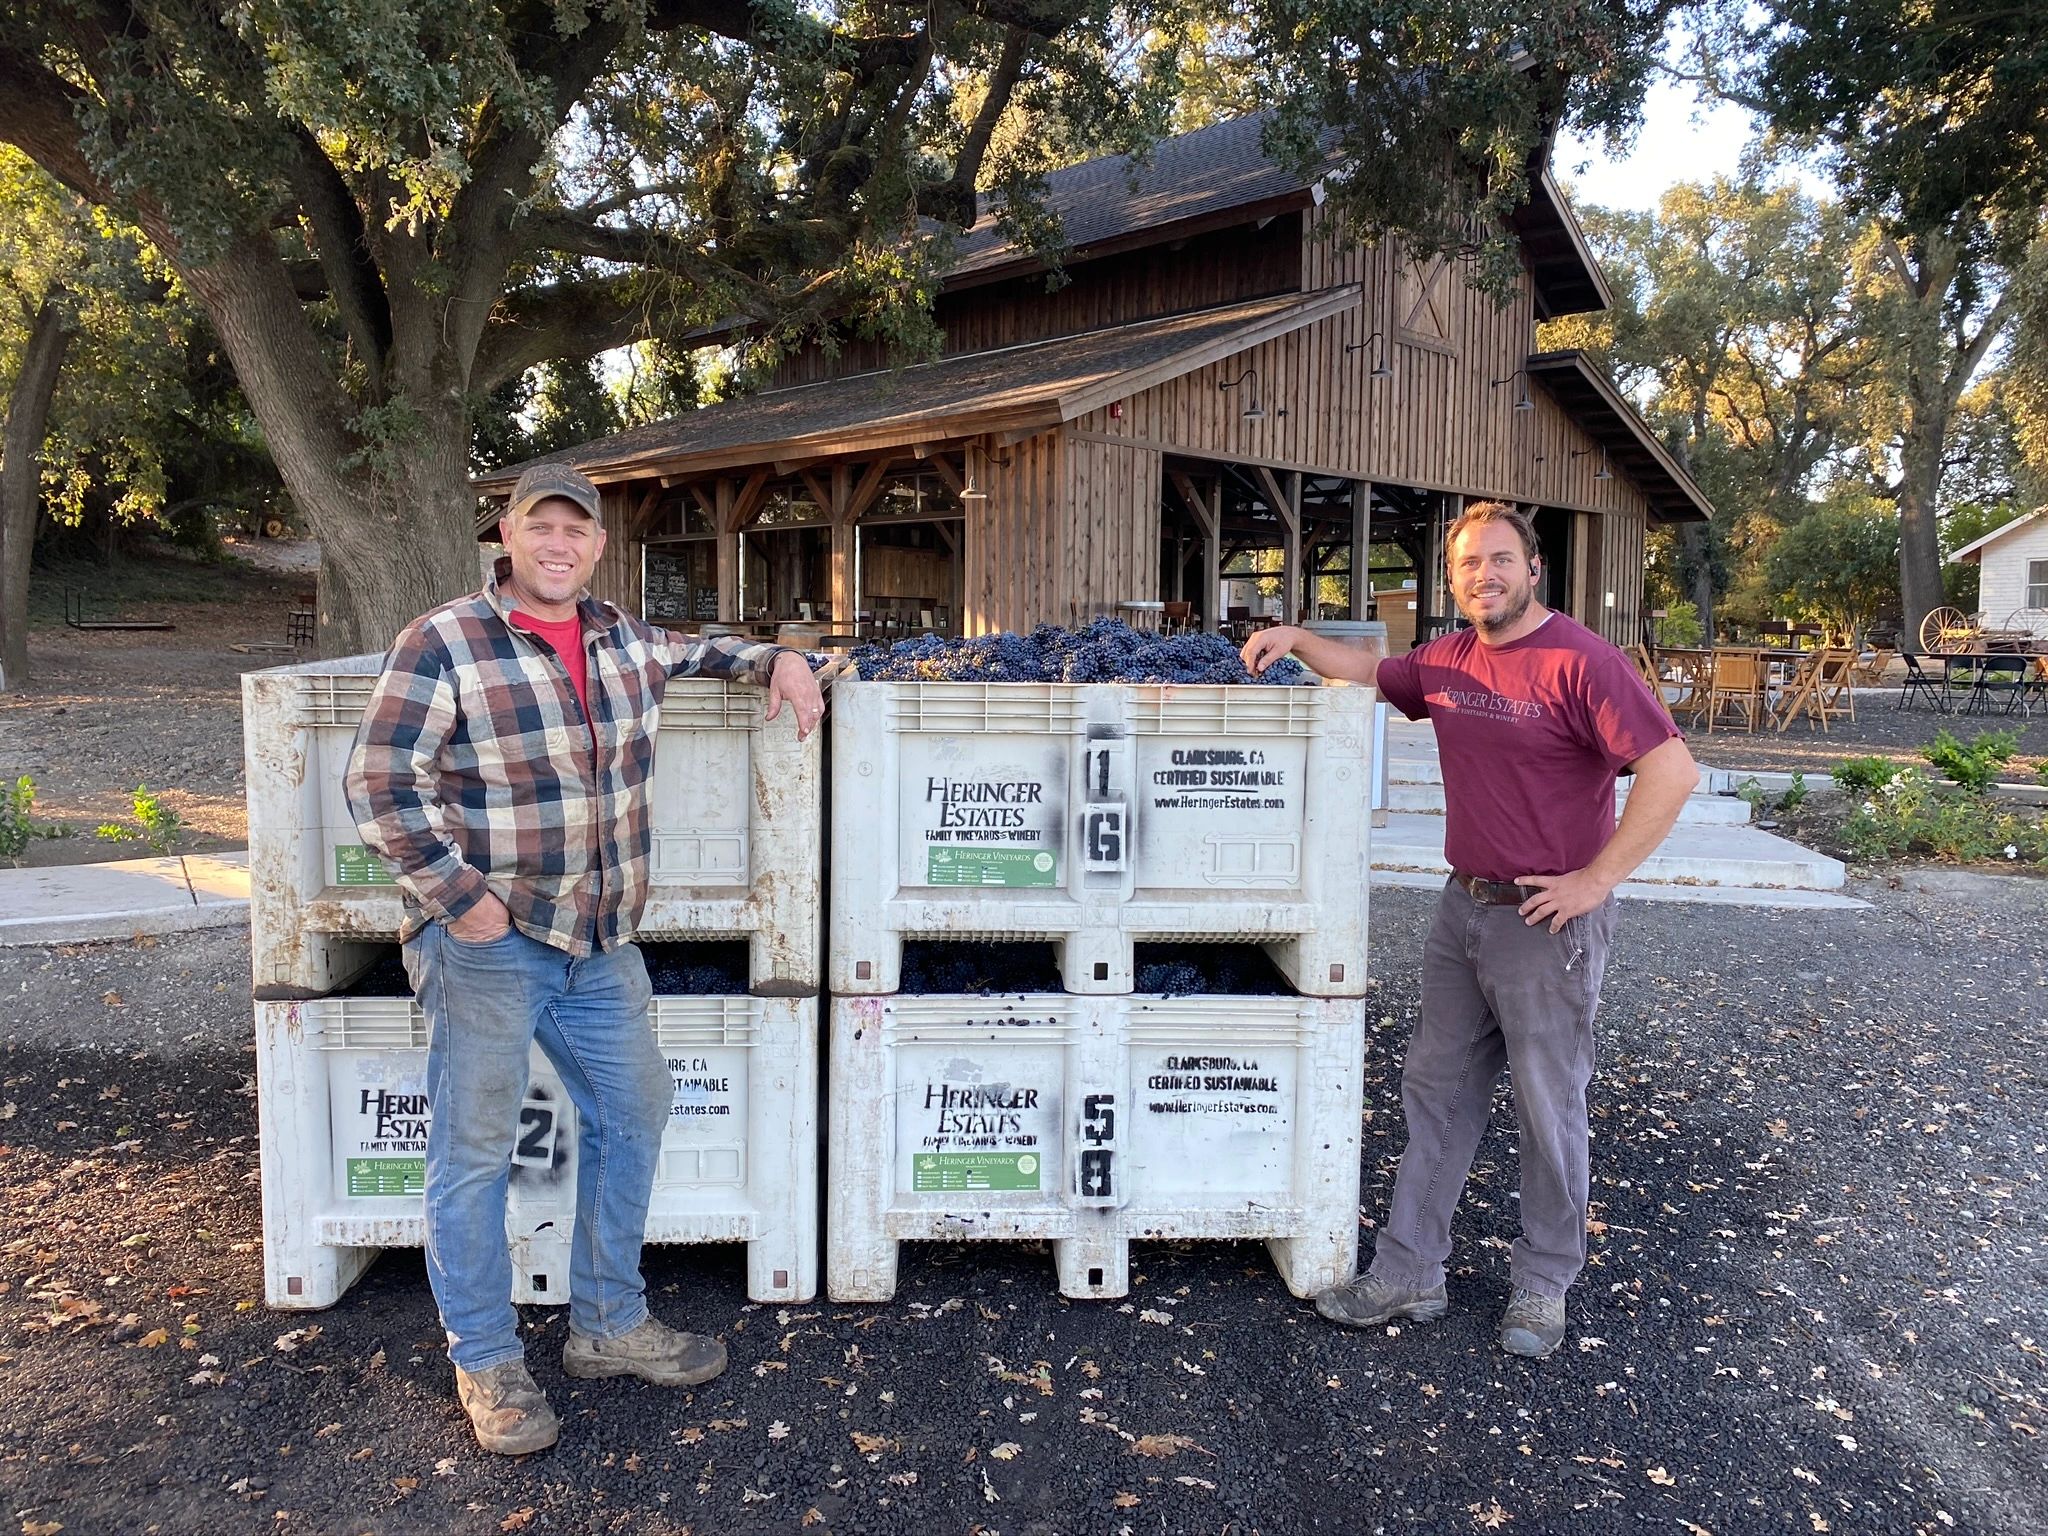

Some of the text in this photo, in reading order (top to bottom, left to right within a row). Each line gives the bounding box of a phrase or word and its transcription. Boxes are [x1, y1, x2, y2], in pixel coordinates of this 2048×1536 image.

[1437, 685, 1543, 718] HERINGER ESTATES
[1495, 713, 1519, 723] WINERY
[1250, 750, 1265, 765] CA
[1153, 769, 1285, 786] CERTIFIED SUSTAINABLE
[925, 777, 1043, 804] HERINGER
[940, 802, 1025, 828] ESTATES
[925, 829, 952, 841] FAMILY
[1008, 829, 1042, 841] WINERY
[954, 850, 1031, 862] HERINGER VINEYARDS
[692, 1058, 708, 1072] CA
[924, 1083, 1039, 1110] HERINGER
[937, 1110, 1021, 1134] ESTATES
[516, 1108, 553, 1158] 2
[360, 1141, 388, 1152] FAMILY
[374, 1161, 412, 1170] HERINGER
[939, 1156, 976, 1165] HERINGER
[976, 1156, 1015, 1165] VINEYARDS
